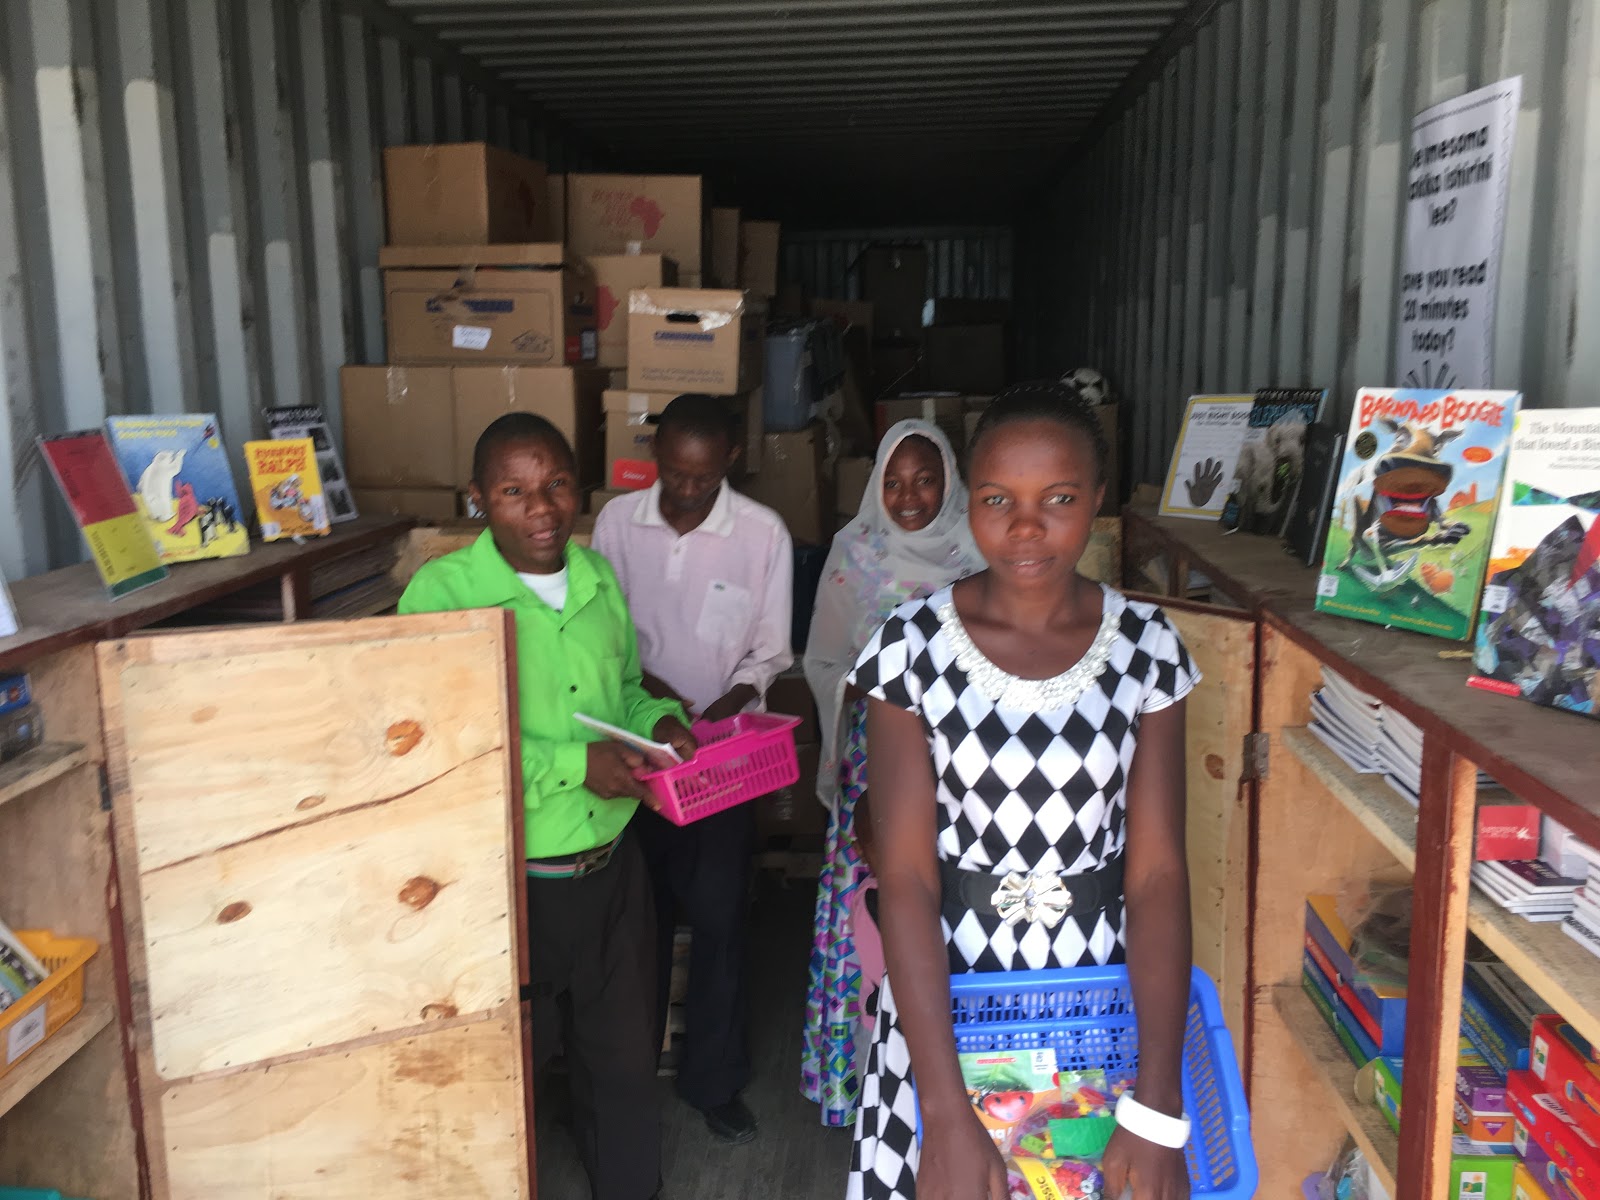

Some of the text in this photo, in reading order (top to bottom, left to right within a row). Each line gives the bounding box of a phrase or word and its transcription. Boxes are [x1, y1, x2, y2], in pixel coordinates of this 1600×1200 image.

[1425, 268, 1450, 295] you
[1450, 258, 1488, 289] read
[1419, 296, 1470, 321] minutes
[1411, 326, 1455, 358] today?
[1359, 394, 1505, 429] BARNYARD BOOGIE
[1529, 421, 1600, 434] The Mountai
[1515, 437, 1537, 450] that
[1538, 436, 1571, 450] loved
[1571, 440, 1580, 450] a
